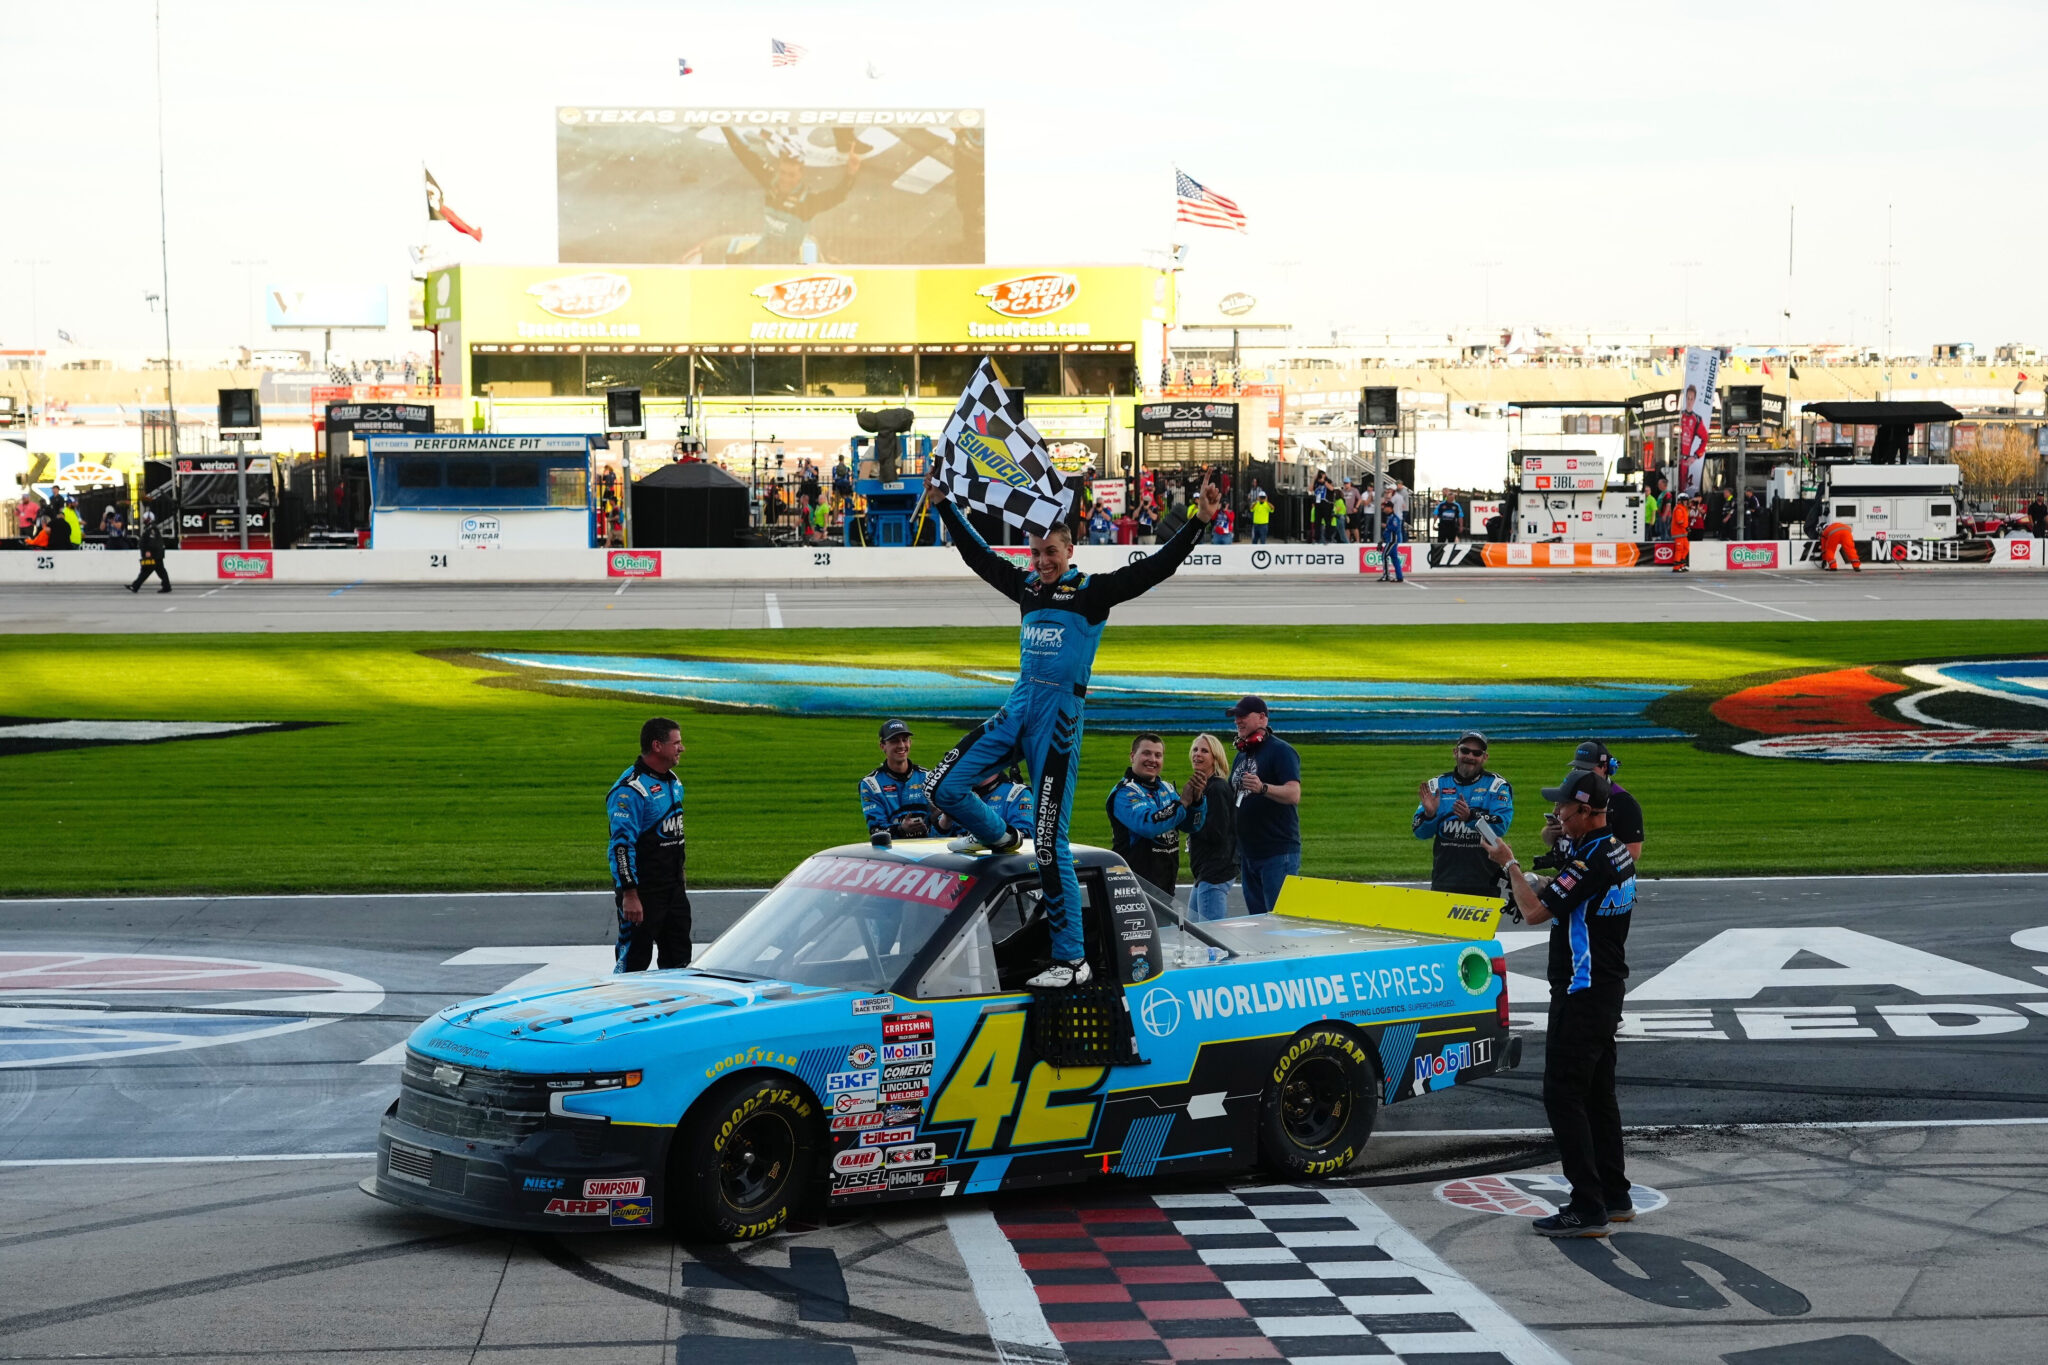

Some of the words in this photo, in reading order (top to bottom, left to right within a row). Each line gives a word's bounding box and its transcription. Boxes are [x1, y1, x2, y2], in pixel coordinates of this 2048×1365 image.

[584, 110, 676, 123] TEXAS
[684, 110, 791, 123] MOTOR
[798, 111, 954, 124] SPEEDWAY
[784, 278, 846, 300] SPEEDY
[1008, 277, 1073, 299] SPEEDY
[517, 321, 640, 338] SpeedyCash.com
[750, 322, 819, 339] VICTORY
[819, 322, 859, 339] LANE
[969, 322, 1090, 338] SpeedyCash.com
[1704, 356, 1718, 406] FERRUCCI
[341, 406, 361, 417] TEXAS
[406, 407, 427, 418] TEXAS
[1152, 405, 1172, 415] TEXAS
[1215, 405, 1233, 415] TEXAS
[354, 422, 381, 430] WINNERS
[383, 422, 404, 430] CIRCLE
[1164, 420, 1191, 428] WINNERS
[1192, 420, 1212, 428] CIRCLE
[414, 438, 516, 450] PERFORMANCE
[519, 438, 541, 449] PIT
[178, 460, 192, 472] 12
[200, 461, 236, 470] verizon
[960, 431, 1028, 488] SUNOCO
[182, 514, 203, 528] 5G
[461, 533, 499, 541] INDYCAR
[1439, 543, 1473, 566] 17
[1731, 547, 1773, 565] O'Reilly
[1871, 540, 1933, 561] Mobil
[37, 556, 54, 570] 25
[222, 554, 267, 574] O'Reilly
[430, 554, 448, 568] 24
[613, 555, 657, 571] O'Reilly
[813, 552, 831, 566] 23
[1275, 554, 1303, 565] NTT
[1306, 554, 1344, 565] DATA
[1036, 775, 1054, 846] WORLDWIDE
[1043, 800, 1058, 848] EXPRESS
[1115, 902, 1147, 912] sparco
[1447, 904, 1494, 923] NIECE
[1187, 974, 1350, 1021] WORLDWIDE
[1350, 963, 1445, 1001] EXPRESS
[866, 997, 889, 1006] NASCAR
[1339, 1007, 1371, 1019] SHIPPING
[1372, 1004, 1407, 1016] LOGISTICS.
[1407, 999, 1456, 1012] SUPERCHARGED.
[884, 1021, 931, 1034] CRAFTSMAN
[428, 1037, 489, 1059] WWEXracing.com
[883, 1044, 919, 1059] Mobil
[705, 1046, 798, 1079] GOODYEAR
[1273, 1031, 1367, 1083] GOODYEAR
[1414, 1041, 1472, 1081] Mobil
[883, 1062, 932, 1078] COMETIC
[828, 1072, 877, 1090] SKF
[881, 1081, 921, 1093] LINCOLN
[929, 1010, 1107, 1153] 42
[890, 1090, 925, 1100] WELDERS
[713, 1087, 812, 1152] GOODYEAR
[832, 1112, 883, 1129] CALICO
[862, 1130, 913, 1145] tilton
[886, 1148, 932, 1164] KOOKS
[1304, 1145, 1354, 1175] EAGLE
[523, 1177, 566, 1190] NIECE
[833, 1169, 887, 1190] JESEL
[890, 1172, 924, 1186] Holley
[588, 1181, 640, 1195] SIMPSON
[546, 1199, 608, 1213] ARP
[613, 1207, 649, 1217] SUNOCO
[734, 1206, 789, 1238] EAGLE
